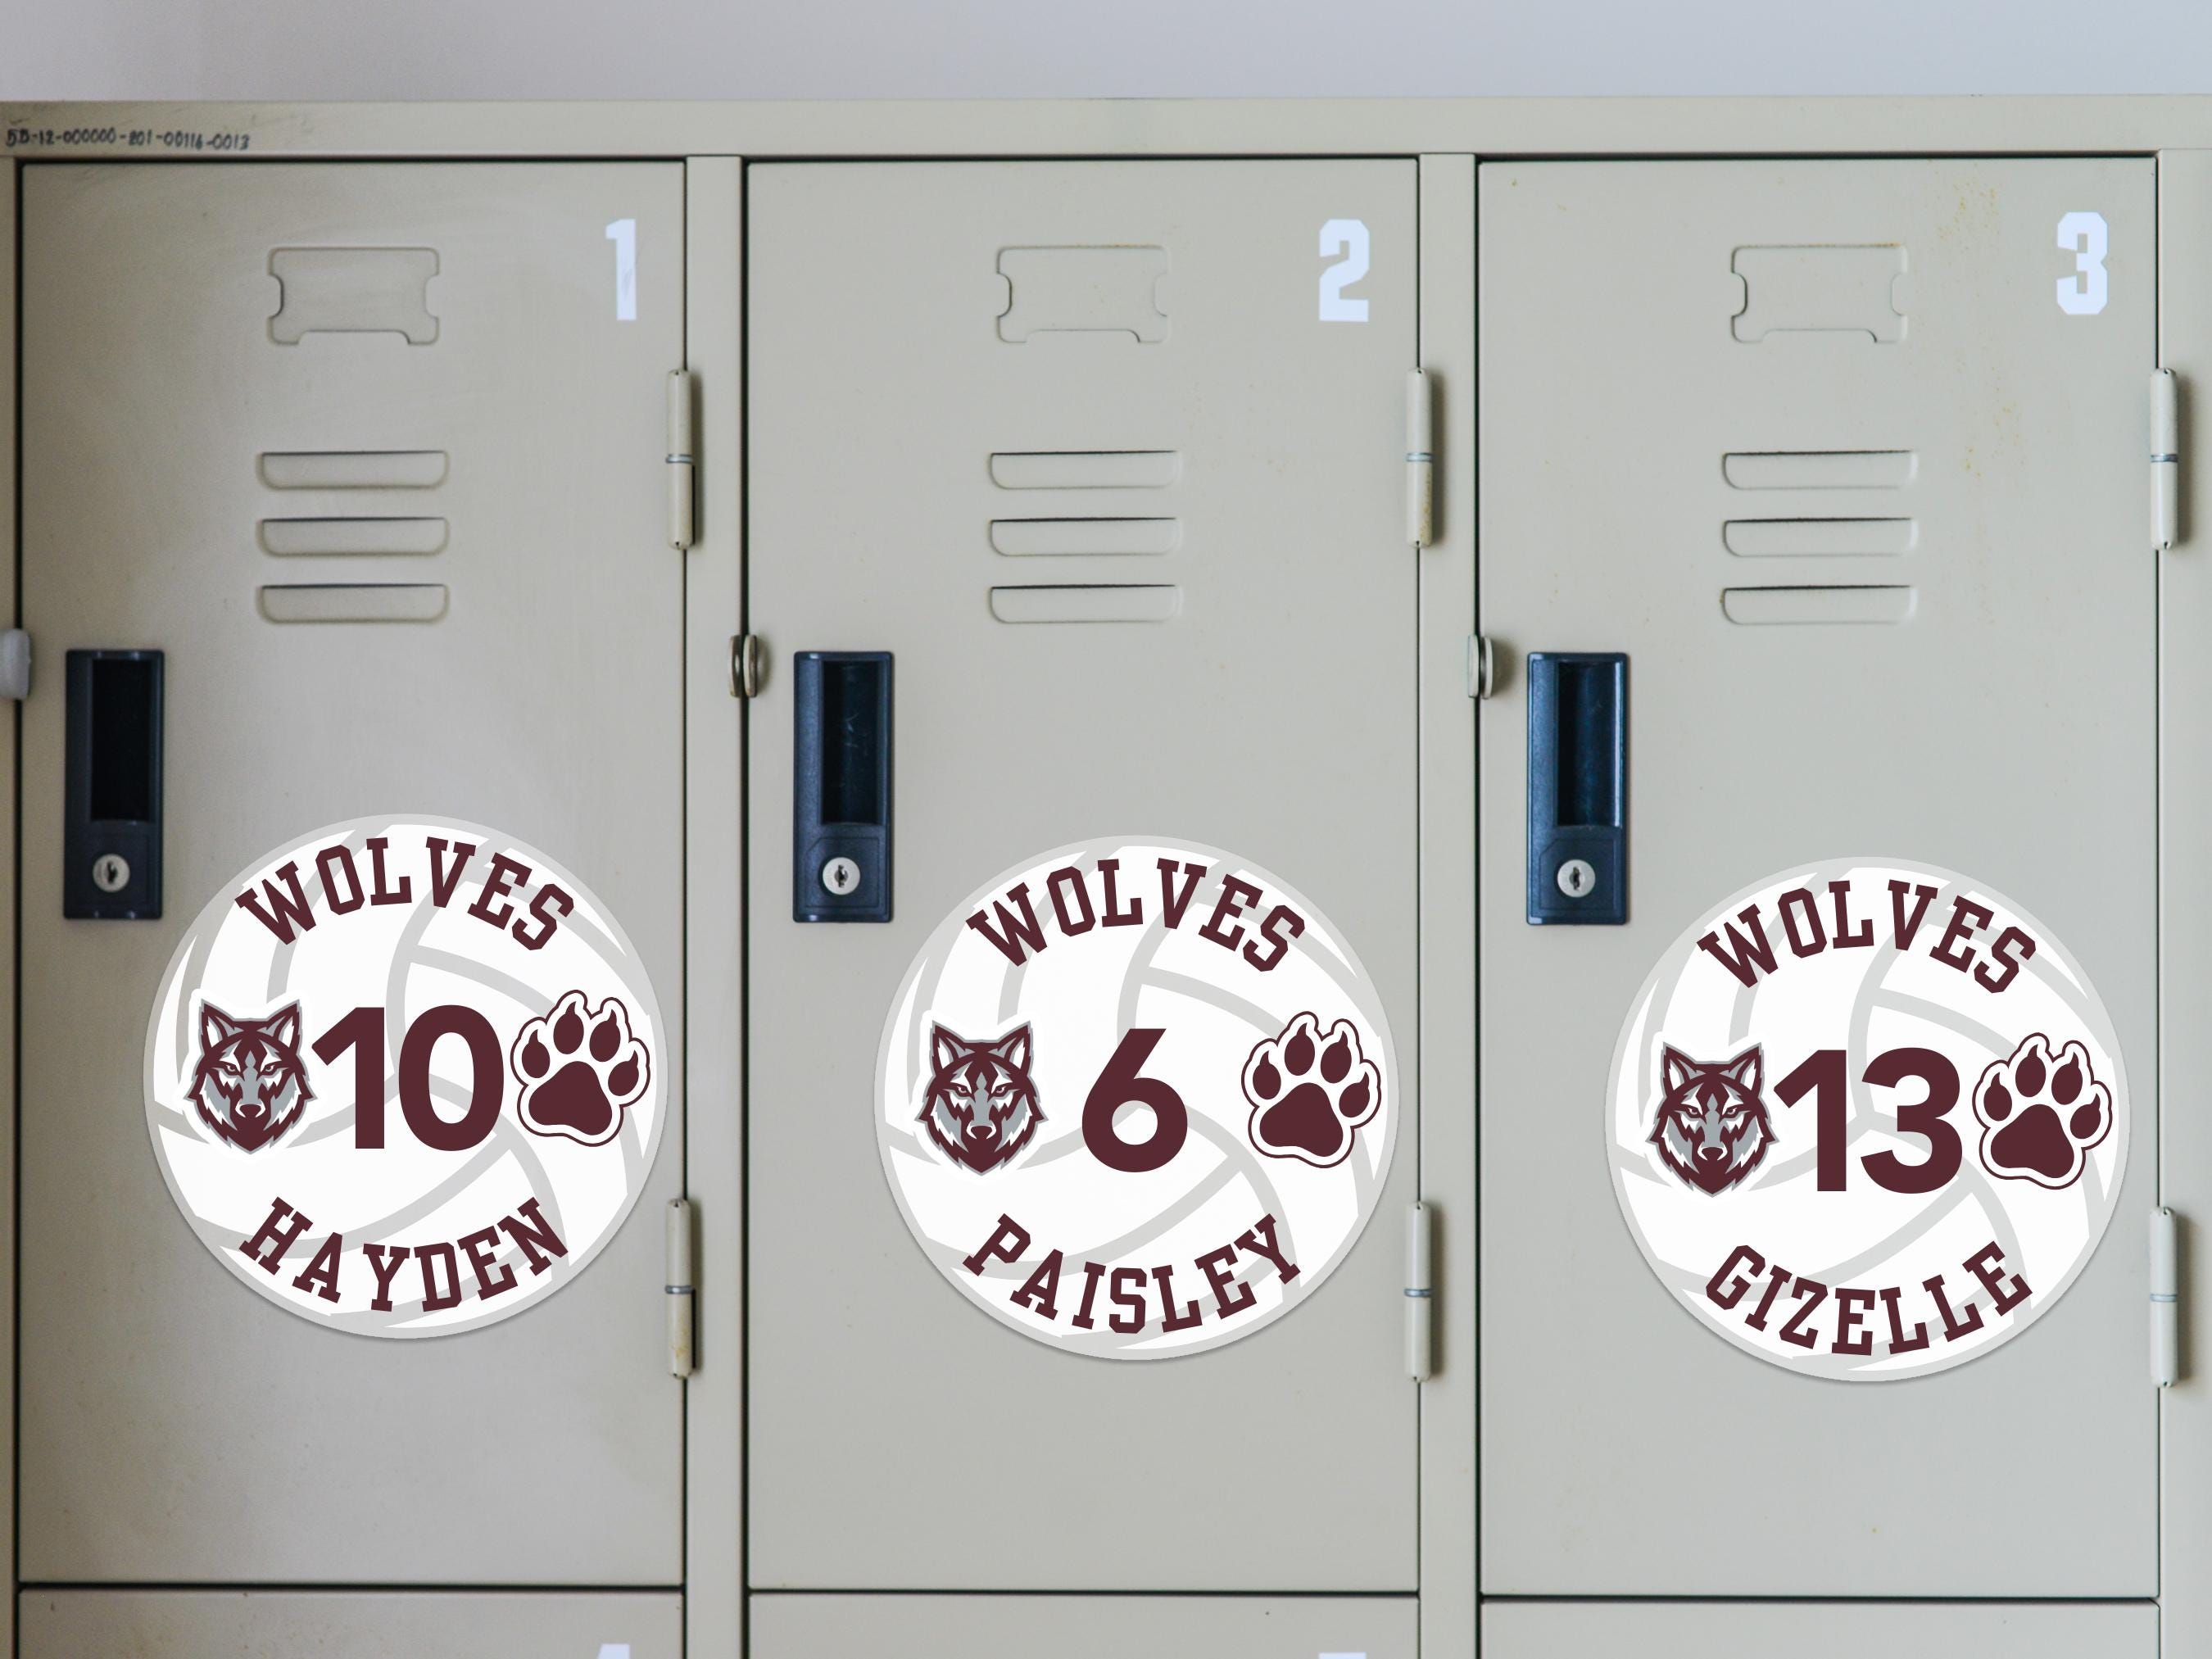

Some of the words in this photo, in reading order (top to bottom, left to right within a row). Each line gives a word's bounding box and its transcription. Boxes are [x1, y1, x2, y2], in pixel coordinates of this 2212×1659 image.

[605, 218, 637, 320] 1
[1319, 219, 1370, 322] 2
[2057, 211, 2108, 315] 3
[235, 836, 573, 950] WOLVES
[966, 858, 1305, 972] WOLVES
[1697, 879, 2036, 993] WOLVES
[312, 1004, 504, 1151] 10
[1082, 1028, 1187, 1172] 6
[1774, 1048, 1962, 1194] 13
[239, 1197, 569, 1312] HAYDEN
[963, 1213, 1300, 1334] PAISLEY
[1706, 1241, 2033, 1356] GIZELLE
